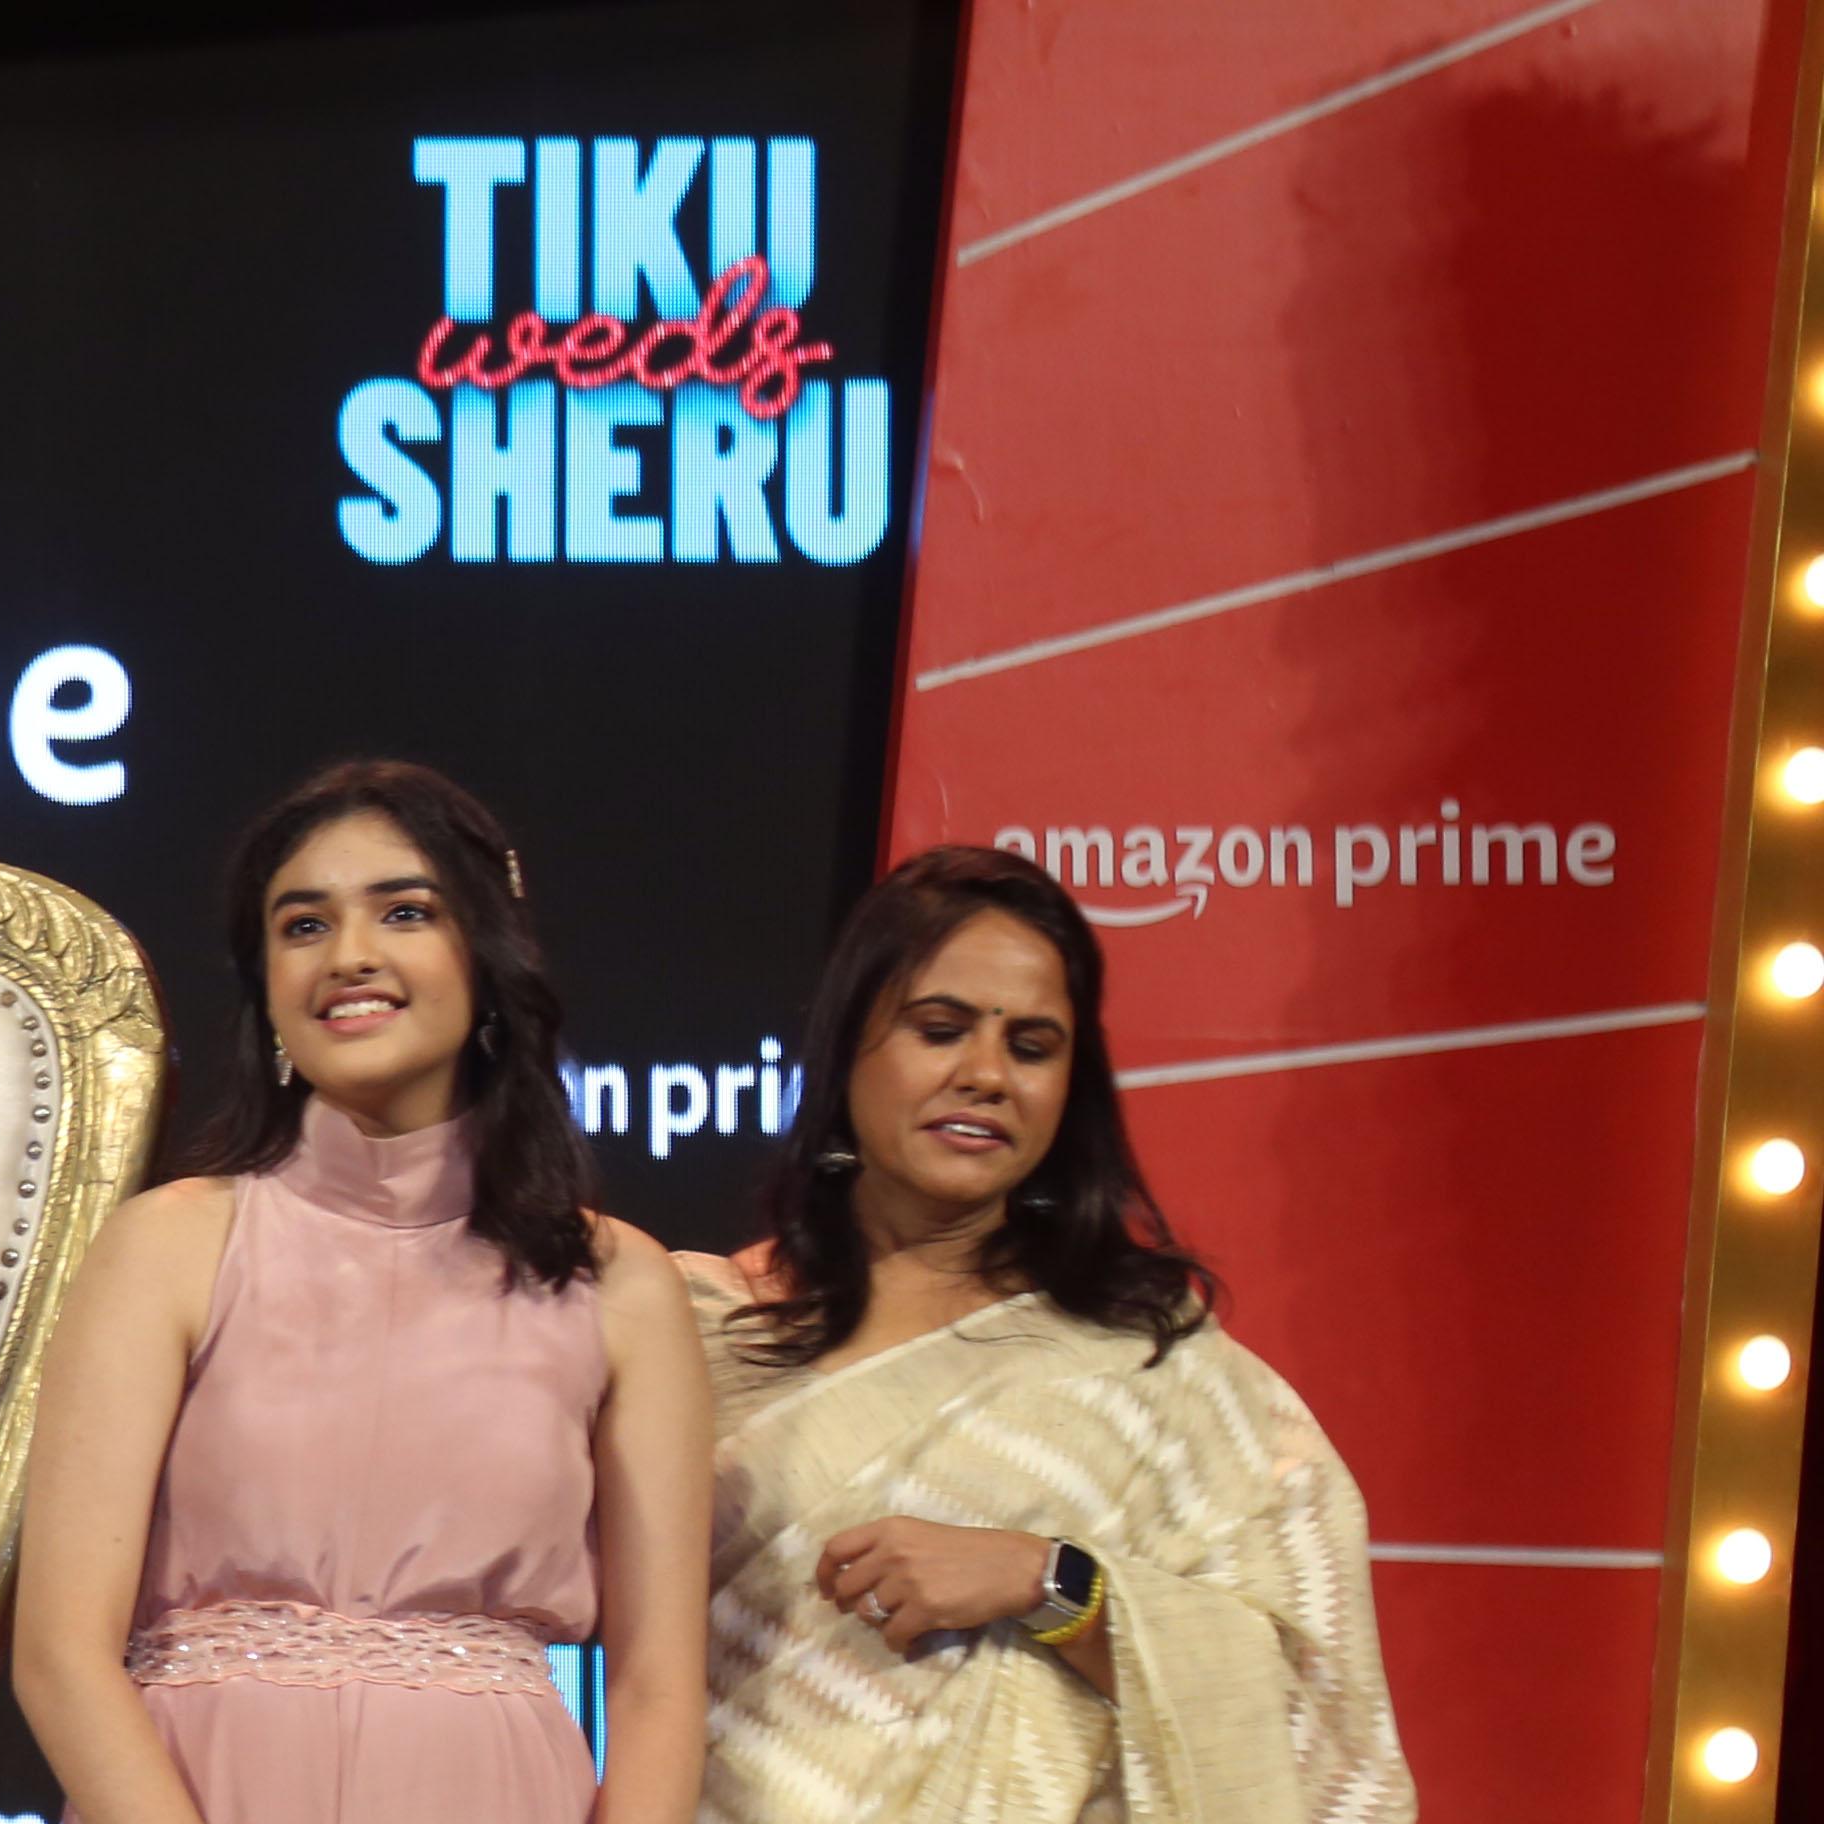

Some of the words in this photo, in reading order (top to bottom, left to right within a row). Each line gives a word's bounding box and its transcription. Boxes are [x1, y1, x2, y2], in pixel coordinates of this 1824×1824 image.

[413, 136, 816, 323] TIKU
[418, 254, 834, 420] weds
[337, 377, 890, 568] SHERU
[1335, 798, 1617, 908] prime
